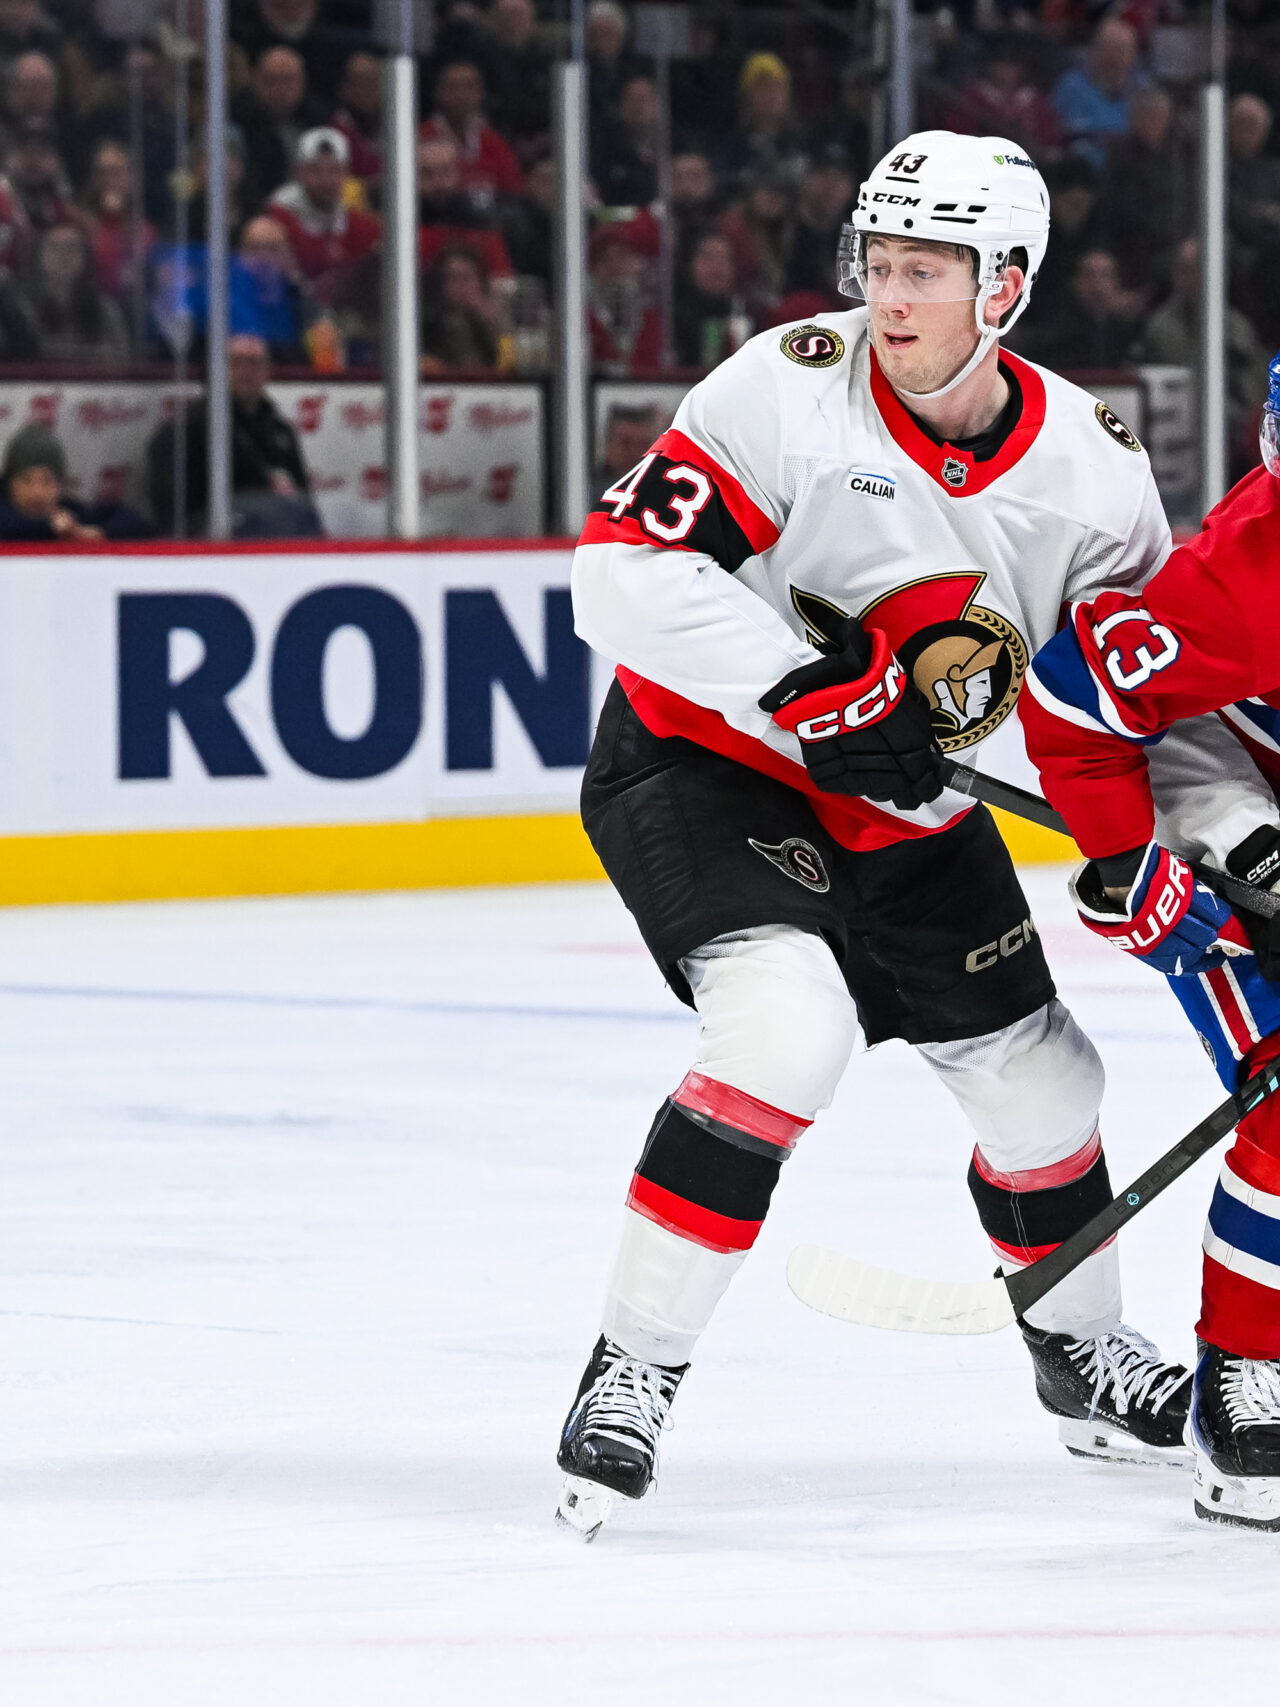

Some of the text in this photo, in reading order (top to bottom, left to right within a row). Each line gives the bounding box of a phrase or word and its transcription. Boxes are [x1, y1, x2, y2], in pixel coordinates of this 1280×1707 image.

[889, 153, 928, 174] 43
[872, 192, 921, 207] CCM
[600, 451, 713, 546] 43
[850, 478, 895, 500] CALIAN
[1092, 608, 1182, 692] 13
[117, 582, 592, 781] RON
[1247, 849, 1279, 882] CCM
[966, 914, 1038, 973] CCM
